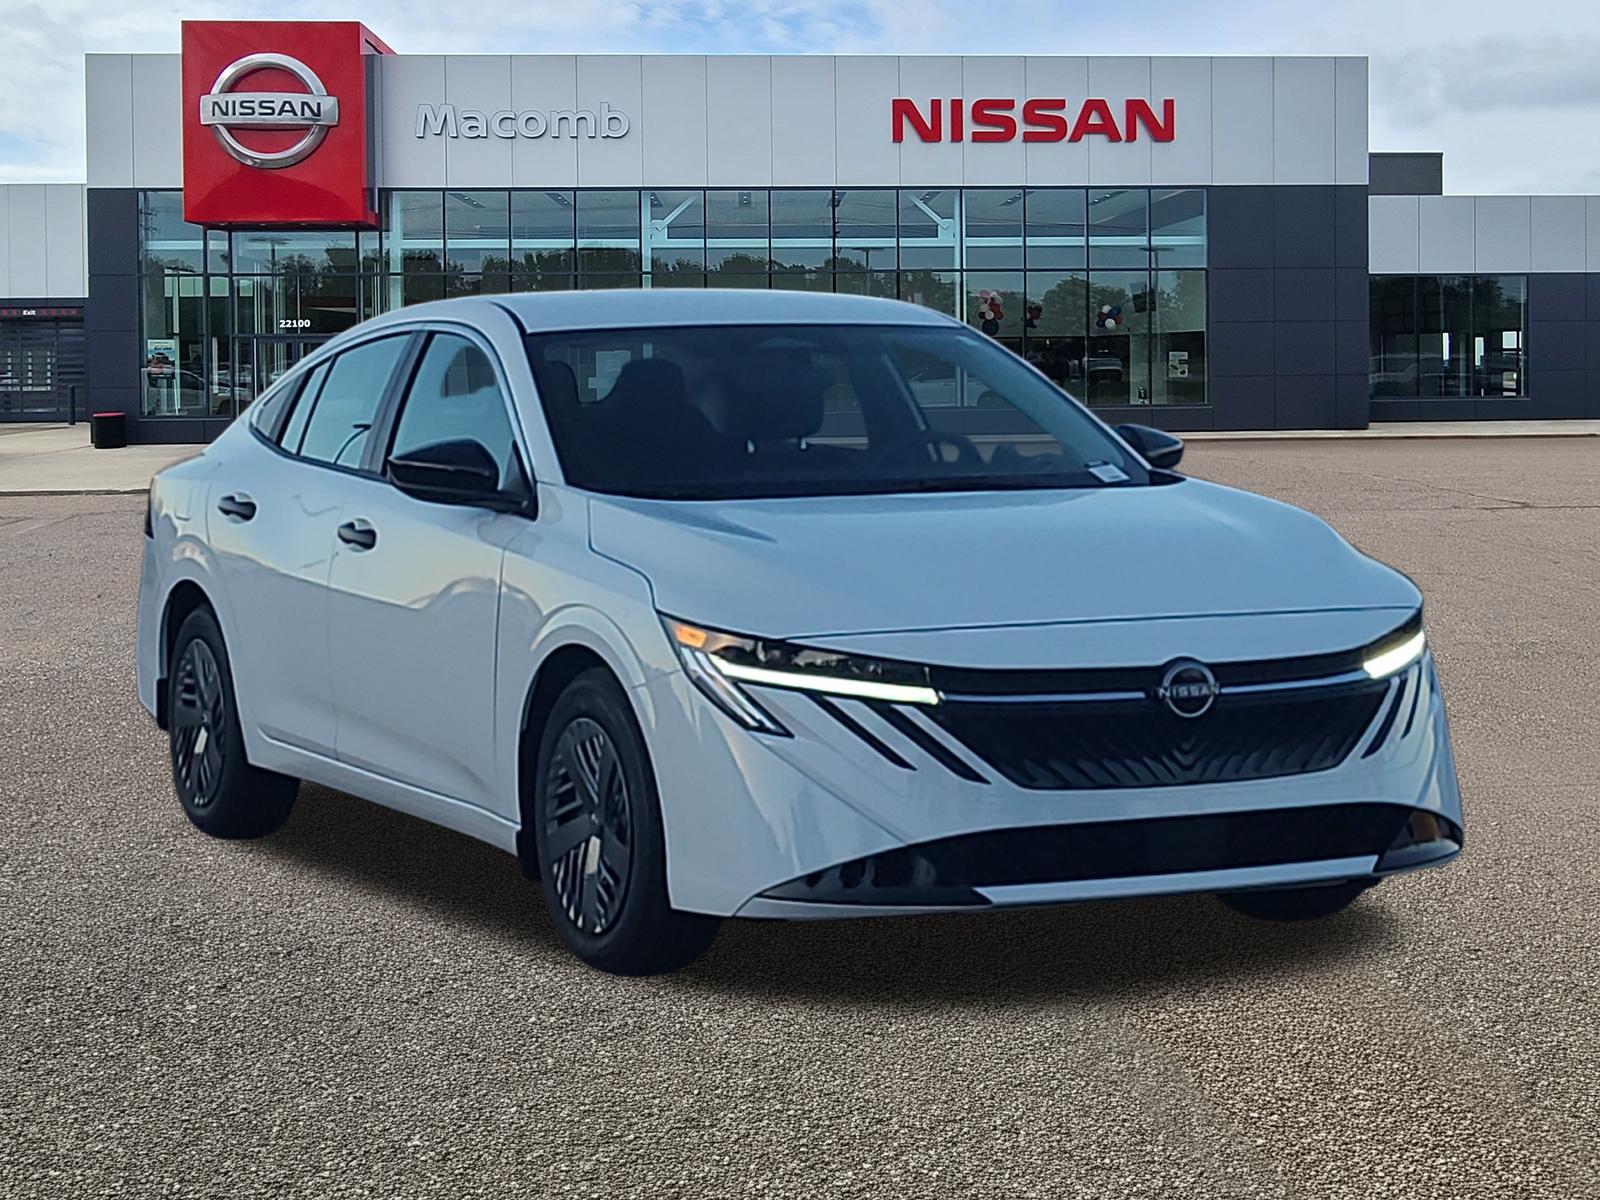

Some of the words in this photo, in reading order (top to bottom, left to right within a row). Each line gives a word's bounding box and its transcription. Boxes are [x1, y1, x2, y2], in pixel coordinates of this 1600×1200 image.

[211, 100, 322, 118] NISSAN
[414, 101, 630, 139] Macomb
[891, 98, 1176, 143] NISSAN
[279, 319, 311, 328] 22100
[1158, 683, 1220, 699] NISSAN
